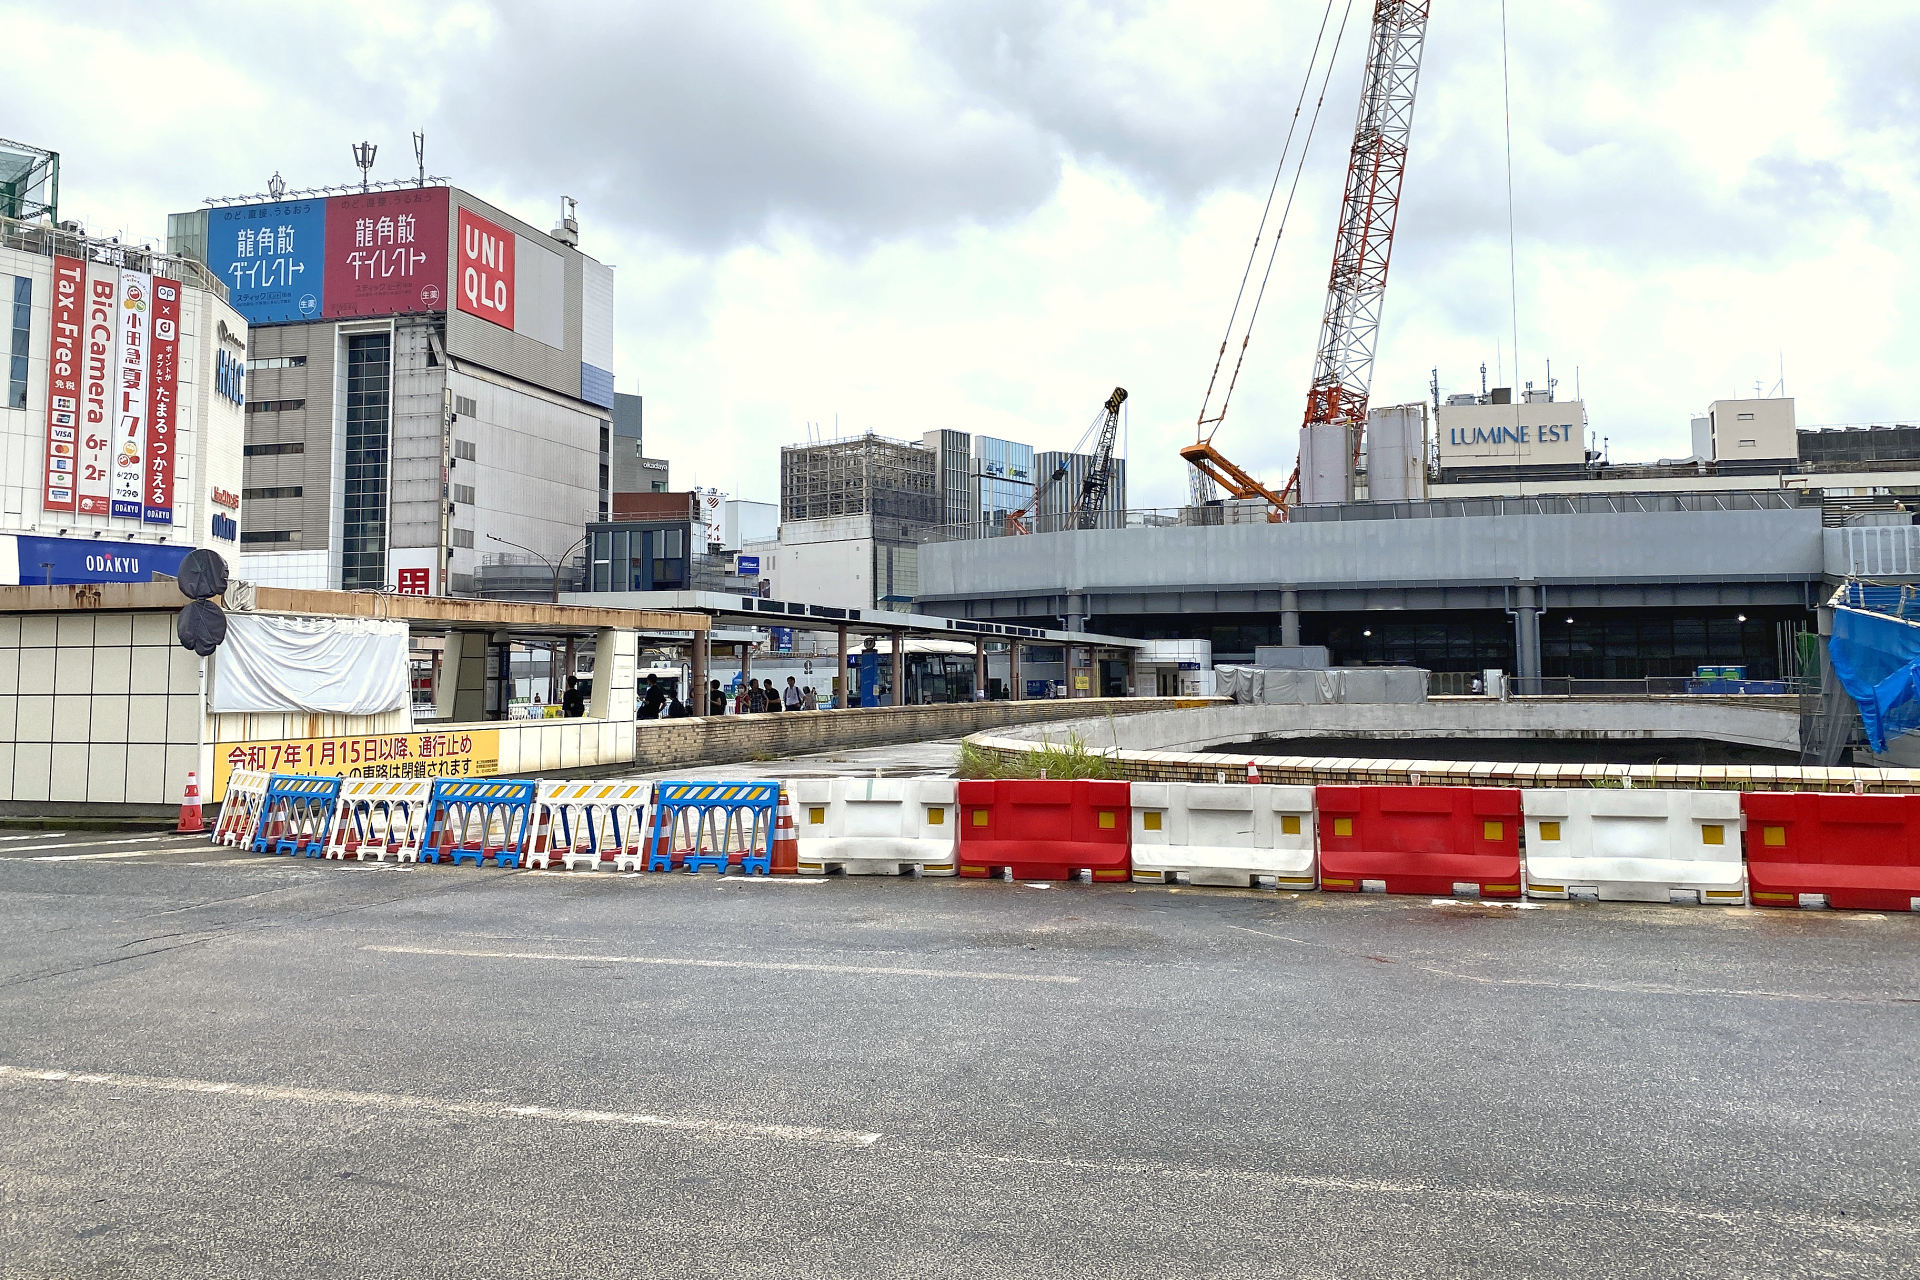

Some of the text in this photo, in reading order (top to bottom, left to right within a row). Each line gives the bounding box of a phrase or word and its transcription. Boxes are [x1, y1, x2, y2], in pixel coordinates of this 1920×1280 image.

[224, 204, 311, 220] のど、直接、うるおう
[237, 224, 295, 258] 龍角散
[355, 213, 416, 247] 龍角散
[465, 224, 504, 273] UNI
[228, 257, 305, 289] ダイレクト
[346, 247, 427, 280] ダイレクト
[236, 292, 267, 302] スティック
[464, 266, 507, 312] QLO
[55, 267, 80, 376] Tax-Free
[87, 280, 114, 423] BicCamera
[165, 345, 173, 381] ポイントが
[120, 313, 142, 437] 小田急夏トク
[155, 354, 163, 384] ダブルで
[55, 379, 75, 390] 免税
[55, 429, 72, 439] VISA
[86, 434, 107, 450] 6F
[1451, 424, 1573, 445] LUMINE EST
[84, 464, 106, 481] 2F
[643, 461, 668, 471] okadaya
[115, 504, 139, 514] ODAKYU
[146, 509, 170, 519] ODAKYU
[86, 554, 139, 573] ODAKYU
[402, 572, 426, 585] ユニ
[228, 733, 473, 772] 令和7年1月15日以降、通行止め
